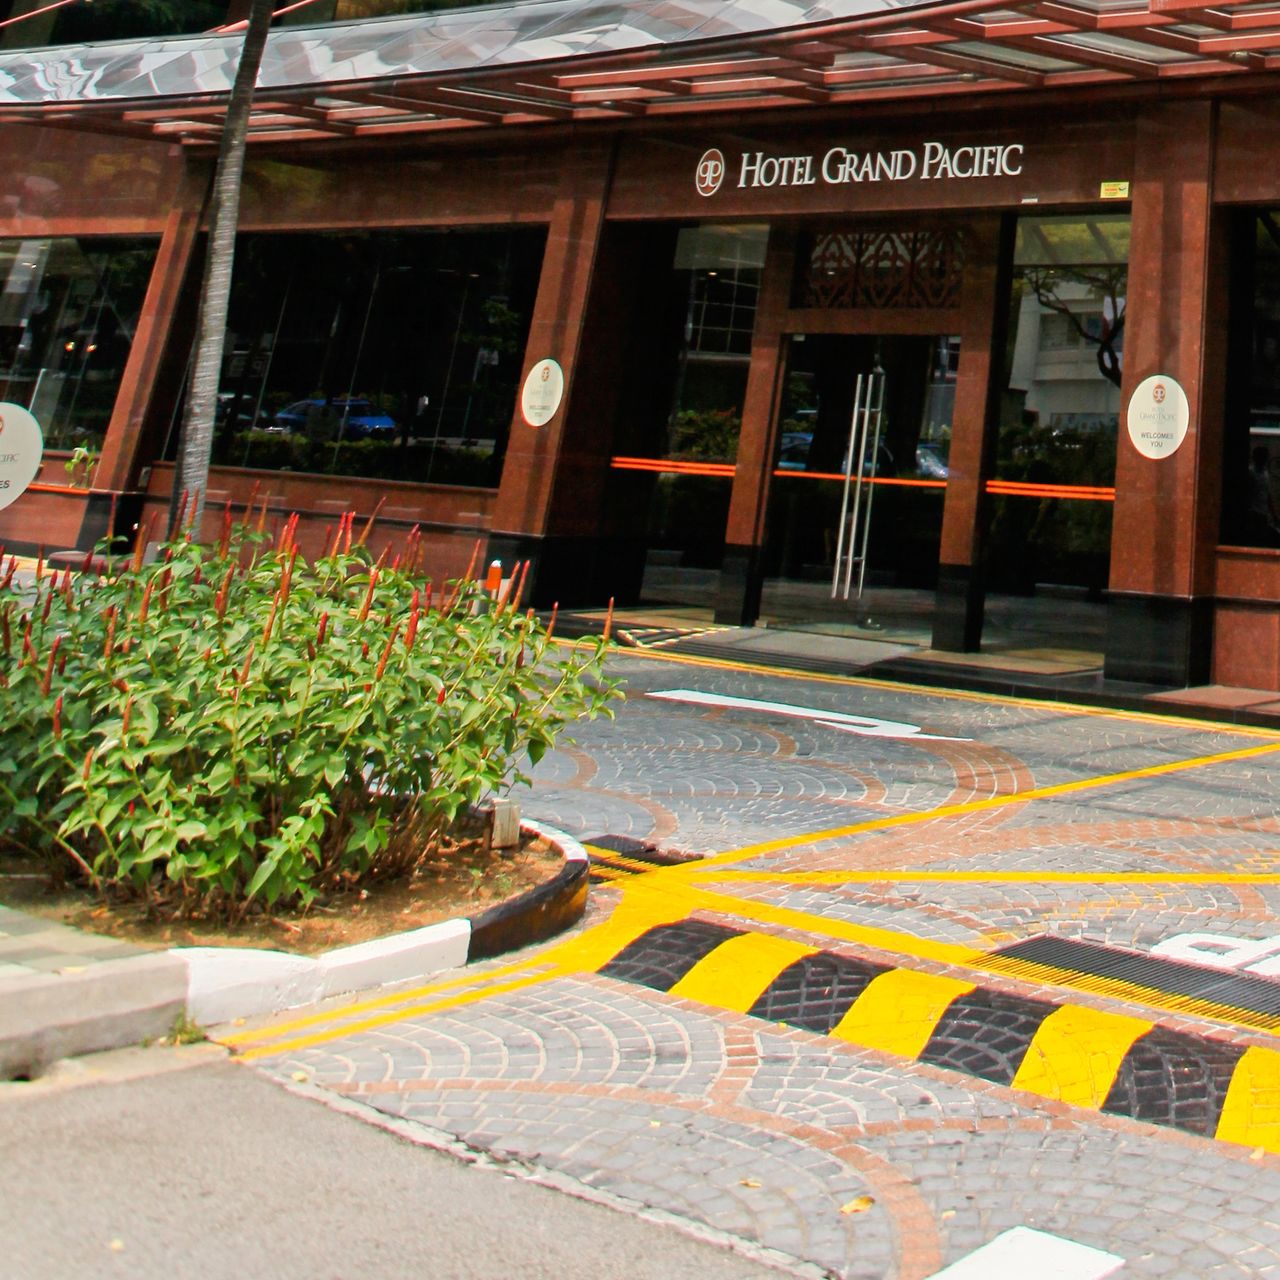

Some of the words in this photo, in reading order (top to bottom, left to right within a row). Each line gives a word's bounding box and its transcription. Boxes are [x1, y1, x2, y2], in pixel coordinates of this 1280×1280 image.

[737, 151, 816, 189] HOTEL
[821, 146, 917, 185] GRAND
[920, 141, 1024, 180] PACIFIC
[1150, 440, 1163, 448] YOU
